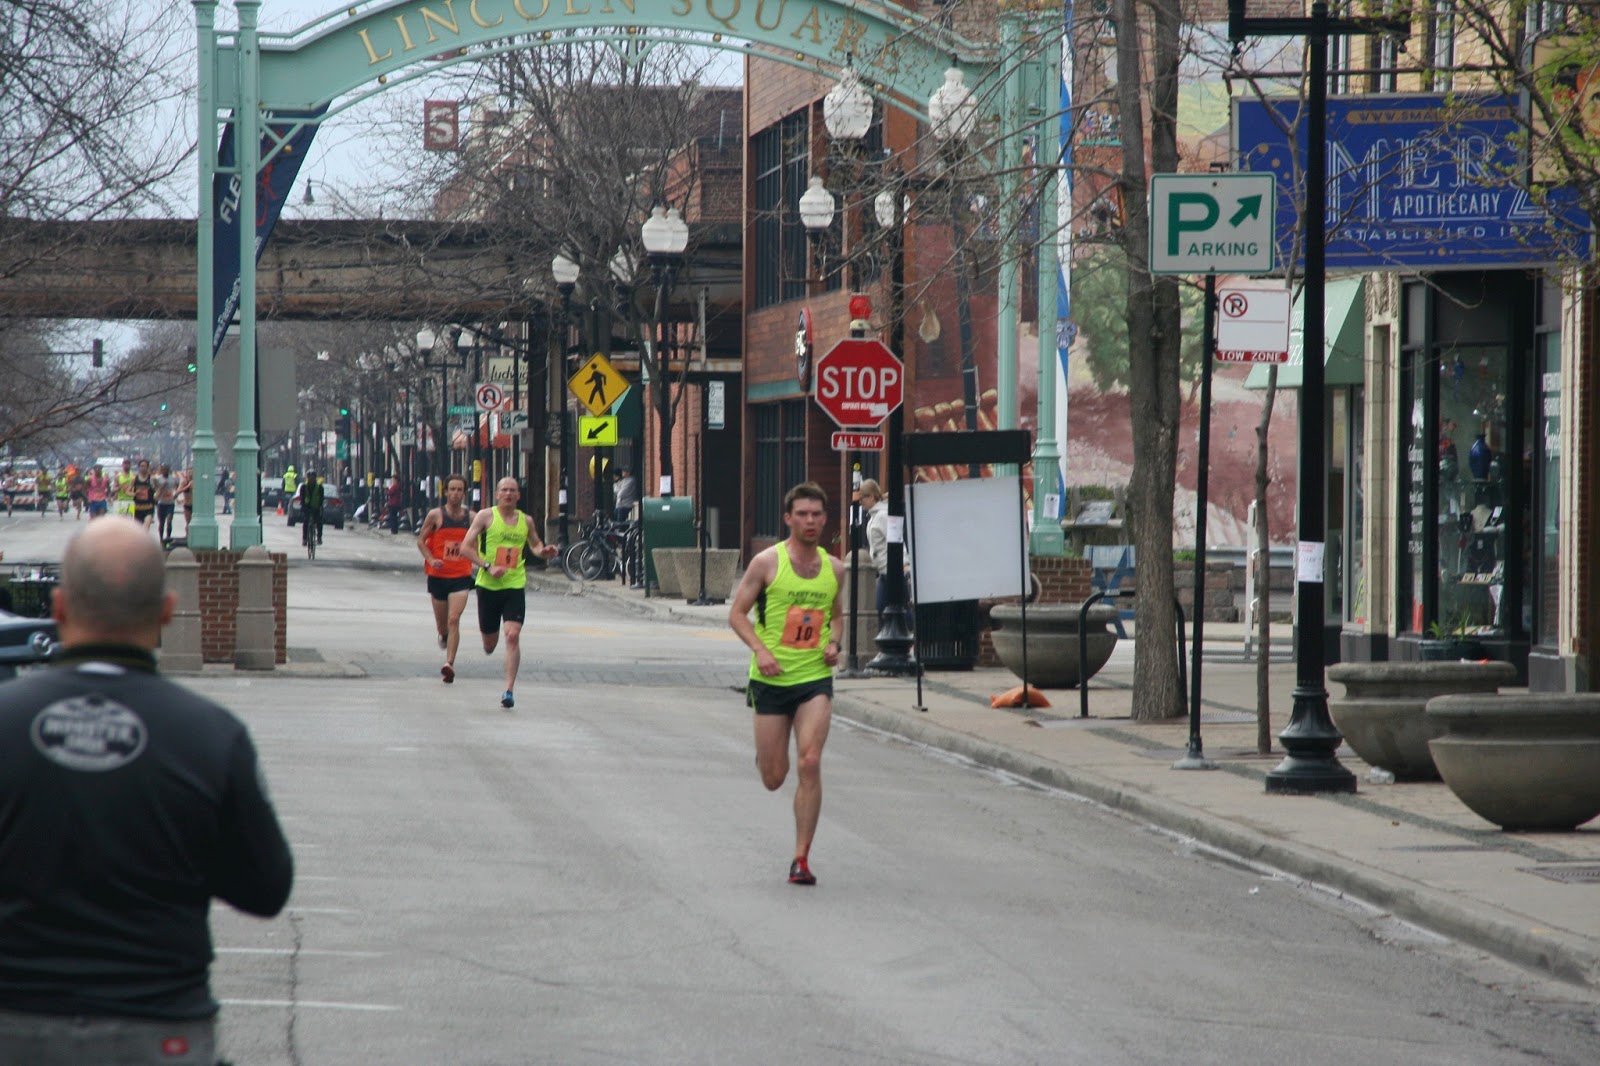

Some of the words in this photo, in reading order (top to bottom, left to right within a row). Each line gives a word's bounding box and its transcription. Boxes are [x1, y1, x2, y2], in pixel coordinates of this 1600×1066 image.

[1392, 193, 1501, 216] APOTHECARY
[1221, 351, 1245, 361] TOW
[1251, 351, 1282, 362] ZONE
[821, 366, 898, 400] STOP
[837, 435, 857, 448] ALL
[860, 435, 880, 448] WAY
[795, 626, 813, 641] 10
